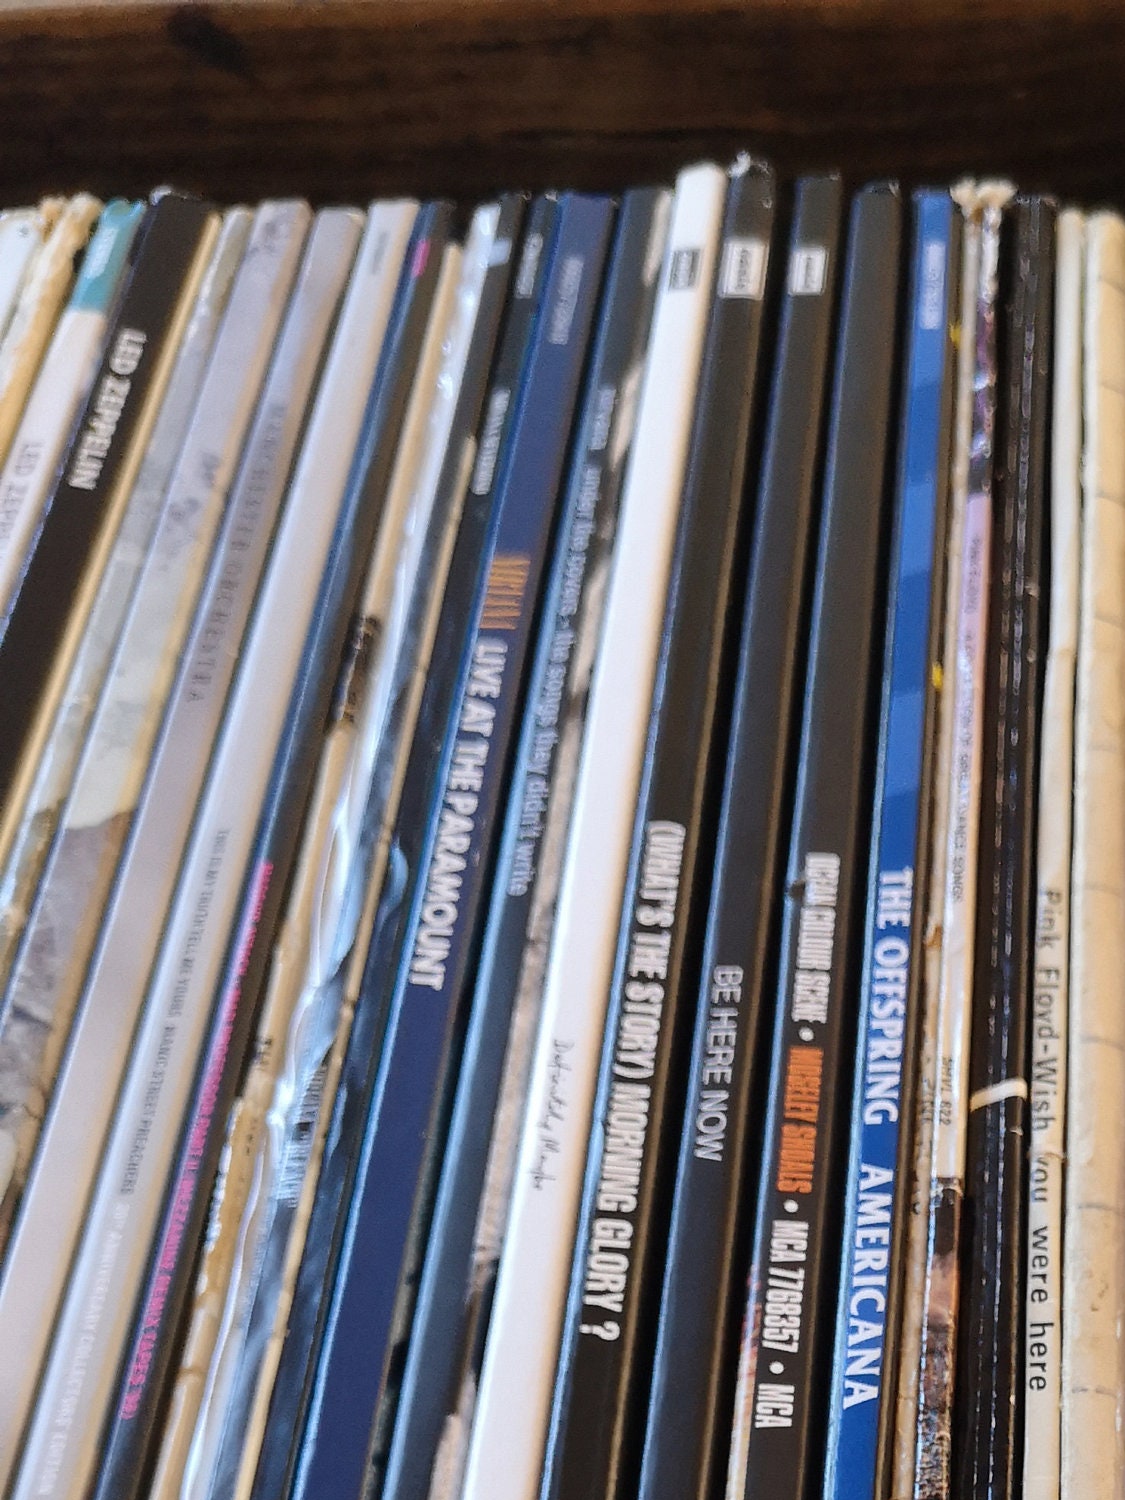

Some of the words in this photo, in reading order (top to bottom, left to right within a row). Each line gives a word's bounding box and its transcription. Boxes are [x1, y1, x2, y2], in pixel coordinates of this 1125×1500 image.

[106, 325, 148, 378] LED
[67, 371, 132, 495] ZEPPELIN
[466, 635, 510, 700] LIVE
[458, 695, 498, 738] AT
[447, 734, 490, 792] THE
[407, 787, 480, 993] PARAMOUNT
[633, 817, 687, 930] (WHAT'S
[873, 865, 914, 931] THE
[627, 928, 671, 982] THE
[1037, 887, 1064, 950] Pink
[710, 962, 744, 1005] BE
[612, 979, 665, 1081] STORY)
[698, 1004, 741, 1087] HERE
[858, 935, 914, 1128] OFFSPRING
[594, 1080, 653, 1214] MORNING
[690, 1087, 731, 1161] NOW
[775, 1122, 817, 1195] SHOALS
[1029, 1151, 1054, 1203] you
[582, 1216, 635, 1314] GLORY
[769, 1218, 810, 1266] MCA
[1029, 1224, 1054, 1305] were
[761, 1265, 806, 1355] 7768357
[837, 1162, 898, 1412] AMERICANA
[578, 1316, 620, 1341] ?
[1026, 1319, 1054, 1393] here
[754, 1381, 796, 1431] MCA
